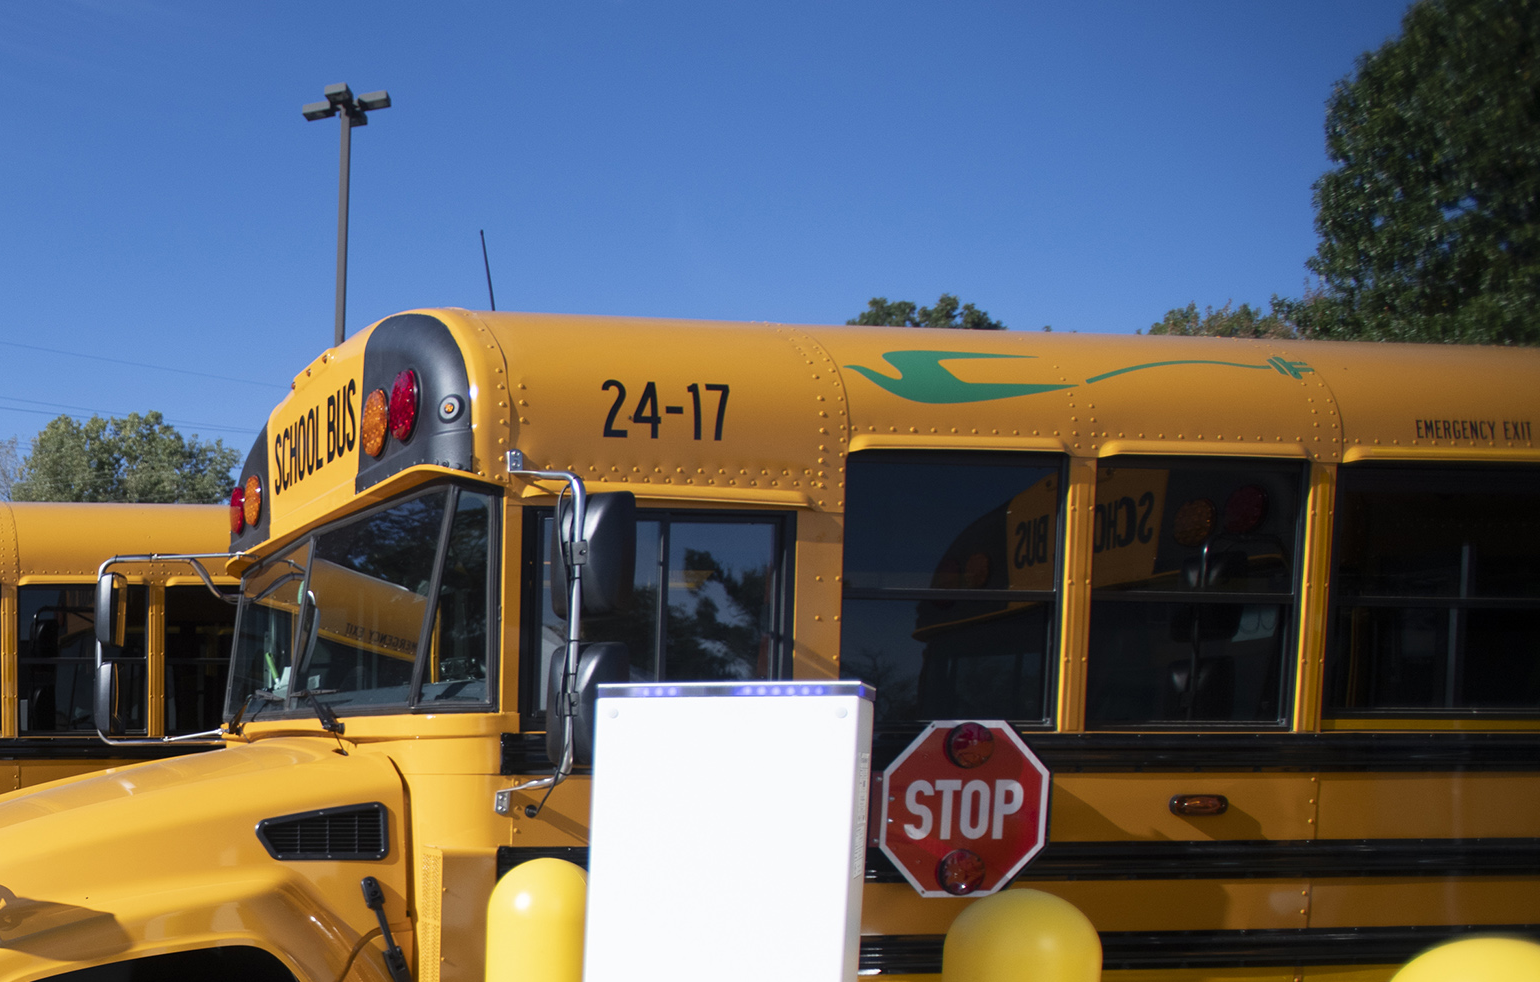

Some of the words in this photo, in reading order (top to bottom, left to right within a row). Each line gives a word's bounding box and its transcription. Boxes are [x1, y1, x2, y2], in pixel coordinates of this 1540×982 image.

[274, 405, 323, 496] SCHOOL
[327, 378, 356, 464] BUS
[601, 379, 730, 441] 24-17
[1415, 419, 1496, 441] EMERGENCY
[1502, 420, 1532, 441] EXIT
[903, 779, 1024, 840] STOP
